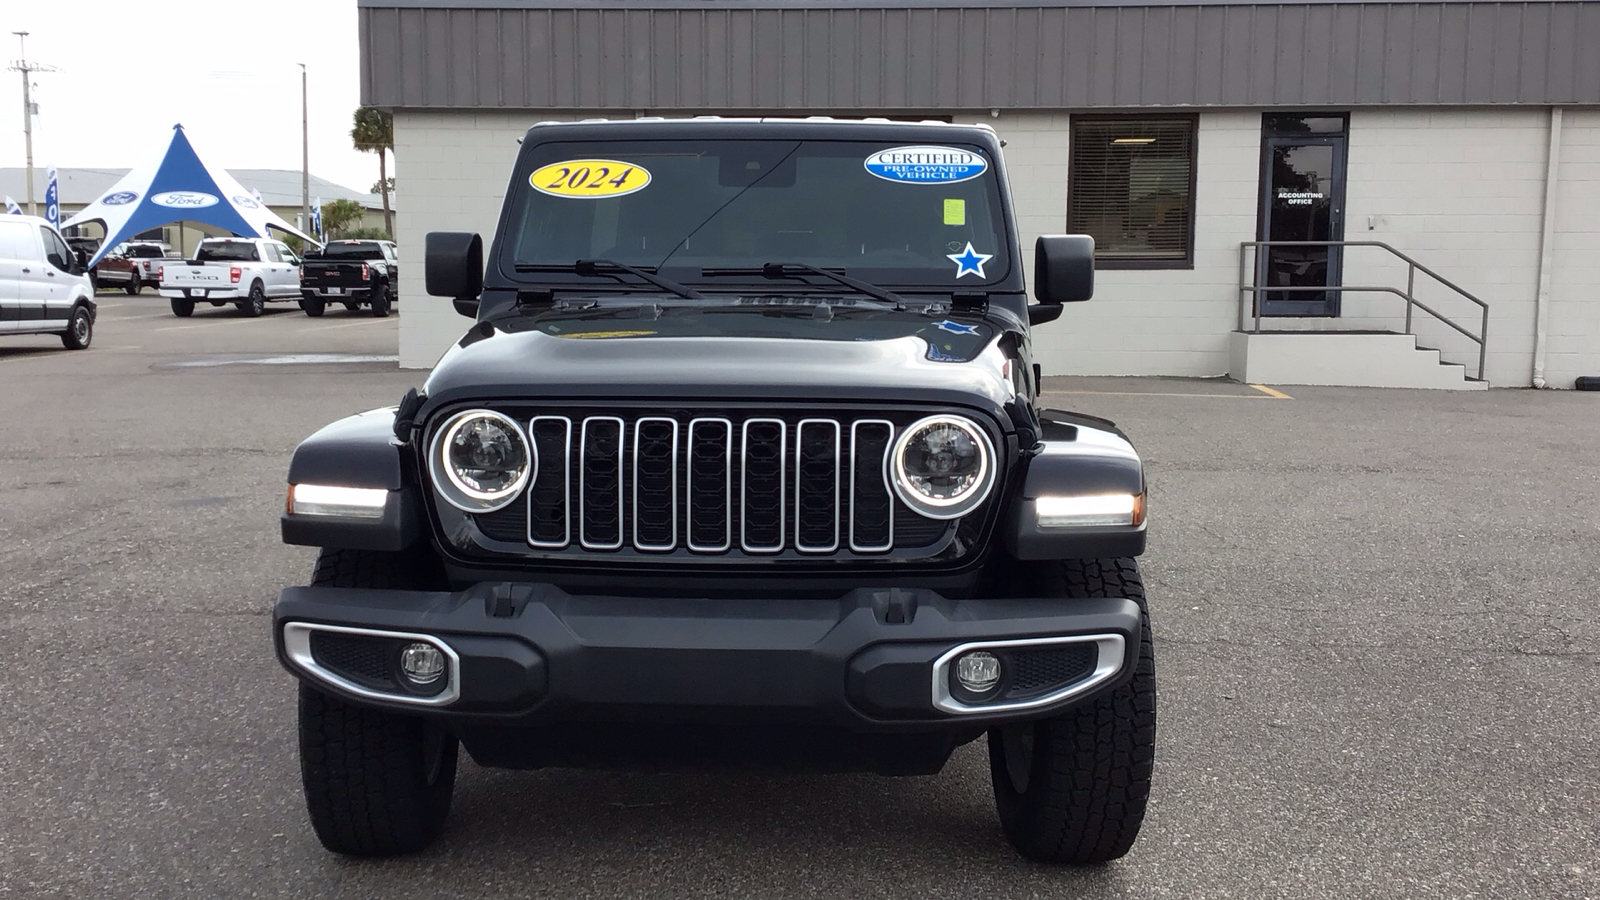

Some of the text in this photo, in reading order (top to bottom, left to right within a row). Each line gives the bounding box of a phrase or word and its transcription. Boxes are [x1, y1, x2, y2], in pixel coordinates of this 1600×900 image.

[878, 153, 973, 164] CERTIFIED
[883, 165, 969, 173] PRE-OWNED
[546, 167, 634, 189] 2024
[165, 194, 205, 205] Ford
